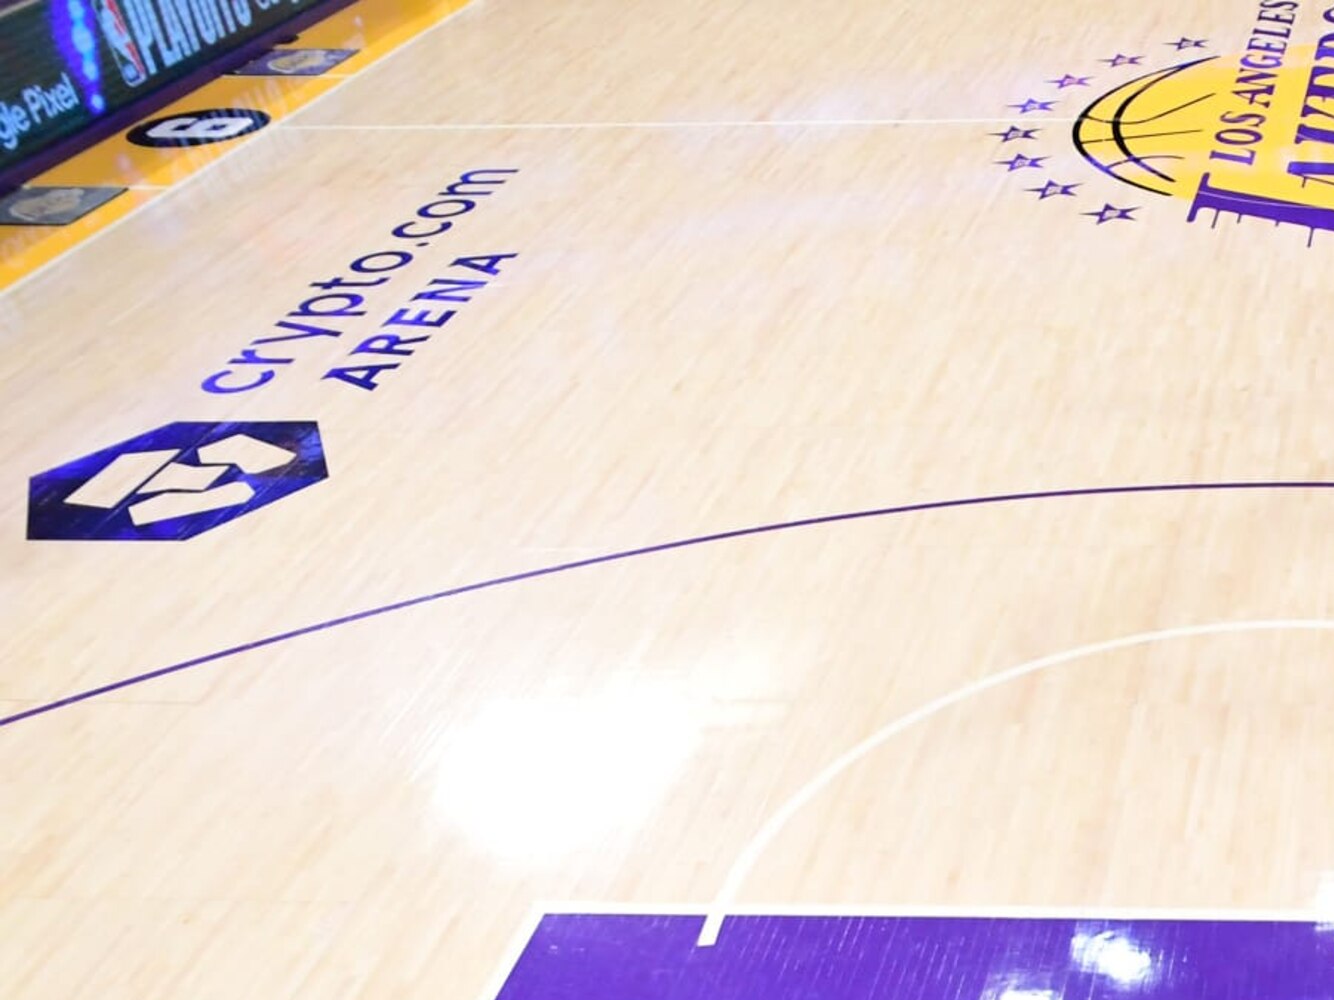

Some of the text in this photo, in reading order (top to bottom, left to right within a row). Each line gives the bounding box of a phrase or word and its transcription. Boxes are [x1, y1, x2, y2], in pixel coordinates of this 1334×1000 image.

[22, 71, 80, 124] Pixel
[1209, 0, 1299, 166] LOS ANGELES
[201, 168, 519, 394] crypto.com
[320, 252, 519, 391] ARENA
